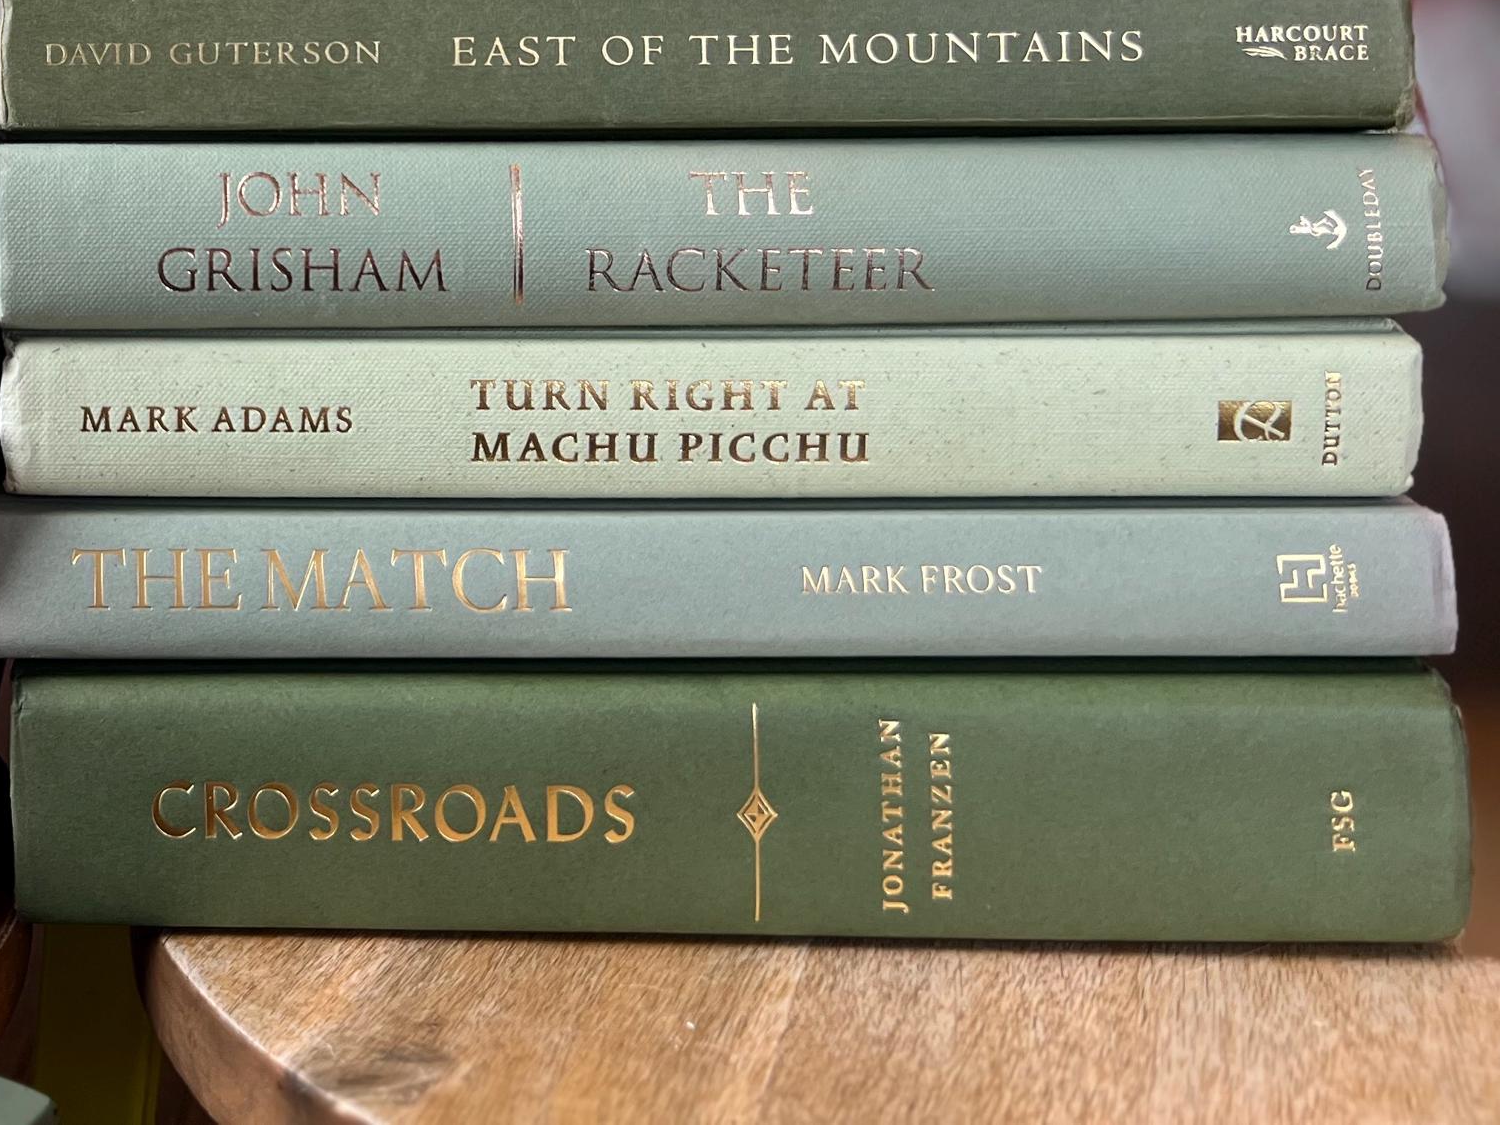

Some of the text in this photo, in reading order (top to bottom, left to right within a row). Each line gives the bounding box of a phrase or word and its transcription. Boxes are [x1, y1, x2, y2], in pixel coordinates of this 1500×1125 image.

[44, 39, 382, 68] DAVID GUTERSON
[451, 29, 1145, 68] EAST OF THE MOUNTAINS
[1235, 23, 1370, 43] HARCOURT
[1293, 44, 1370, 63] BRACE
[216, 171, 382, 230] JOHN
[688, 170, 815, 217] THE
[1363, 168, 1384, 292] DOUBLEDAY
[157, 246, 448, 294] GRISHAM
[587, 246, 936, 294] RACKETEER
[470, 379, 866, 411] TURN RIGHT AT
[1321, 370, 1342, 466] DUTTON
[80, 406, 354, 434] MARK ADAMS
[470, 432, 869, 463] MACHU PICCHU
[70, 547, 573, 612] THE MATCH
[800, 565, 1043, 595] MARK FROST
[151, 782, 637, 844] CROSSROADS
[878, 718, 910, 914] JONATHAN
[929, 731, 953, 901] FRANZEN
[1331, 789, 1356, 854] FSG
